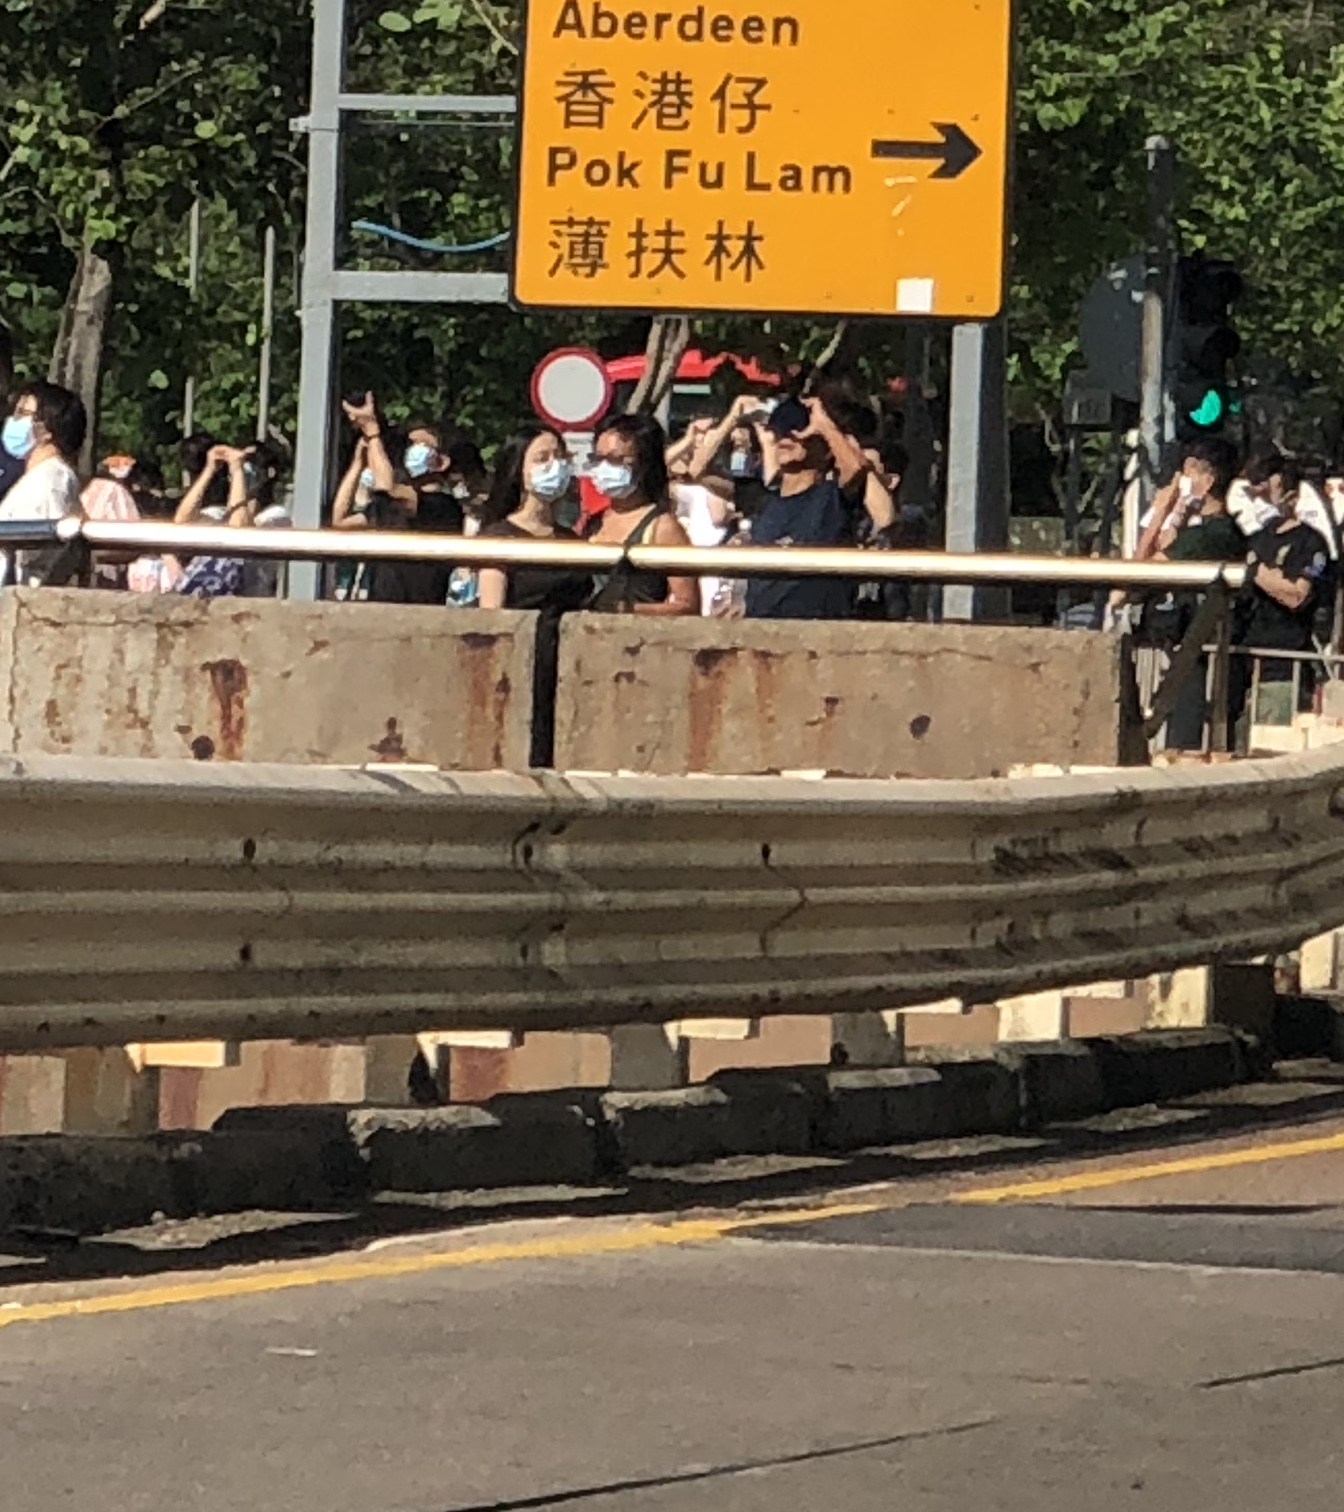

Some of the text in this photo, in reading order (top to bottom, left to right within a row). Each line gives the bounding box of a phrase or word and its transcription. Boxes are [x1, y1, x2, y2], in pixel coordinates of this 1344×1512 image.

[554, 68, 772, 134] 香港仔
[547, 146, 852, 194] Pok Fu Lam
[548, 215, 765, 283] 薄扶林
